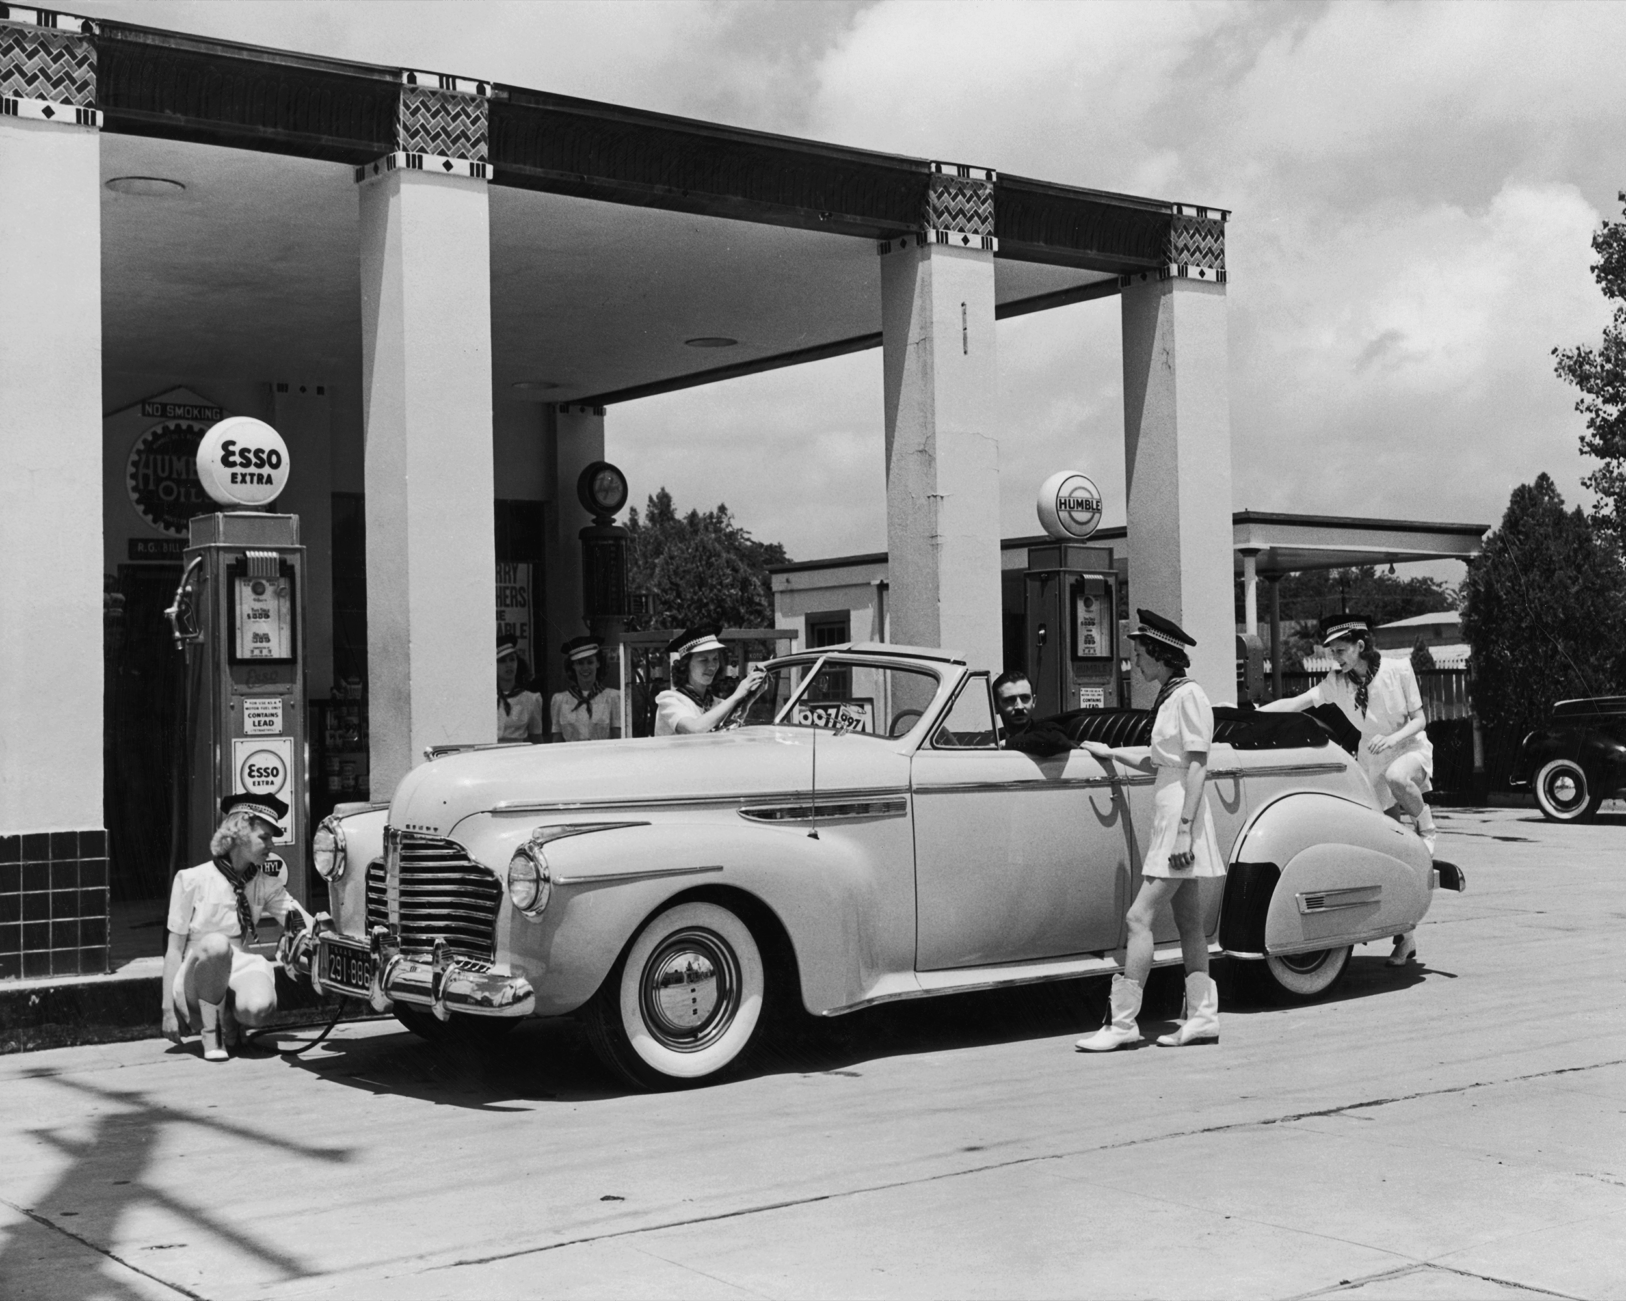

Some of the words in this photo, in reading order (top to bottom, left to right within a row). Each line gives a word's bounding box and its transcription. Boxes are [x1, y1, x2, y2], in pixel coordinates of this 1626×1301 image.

[145, 403, 162, 416] NO
[166, 405, 221, 420] SMOKING
[231, 472, 274, 486] EXTRA
[1059, 498, 1101, 511] HUMBLE
[252, 719, 275, 727] LEAD
